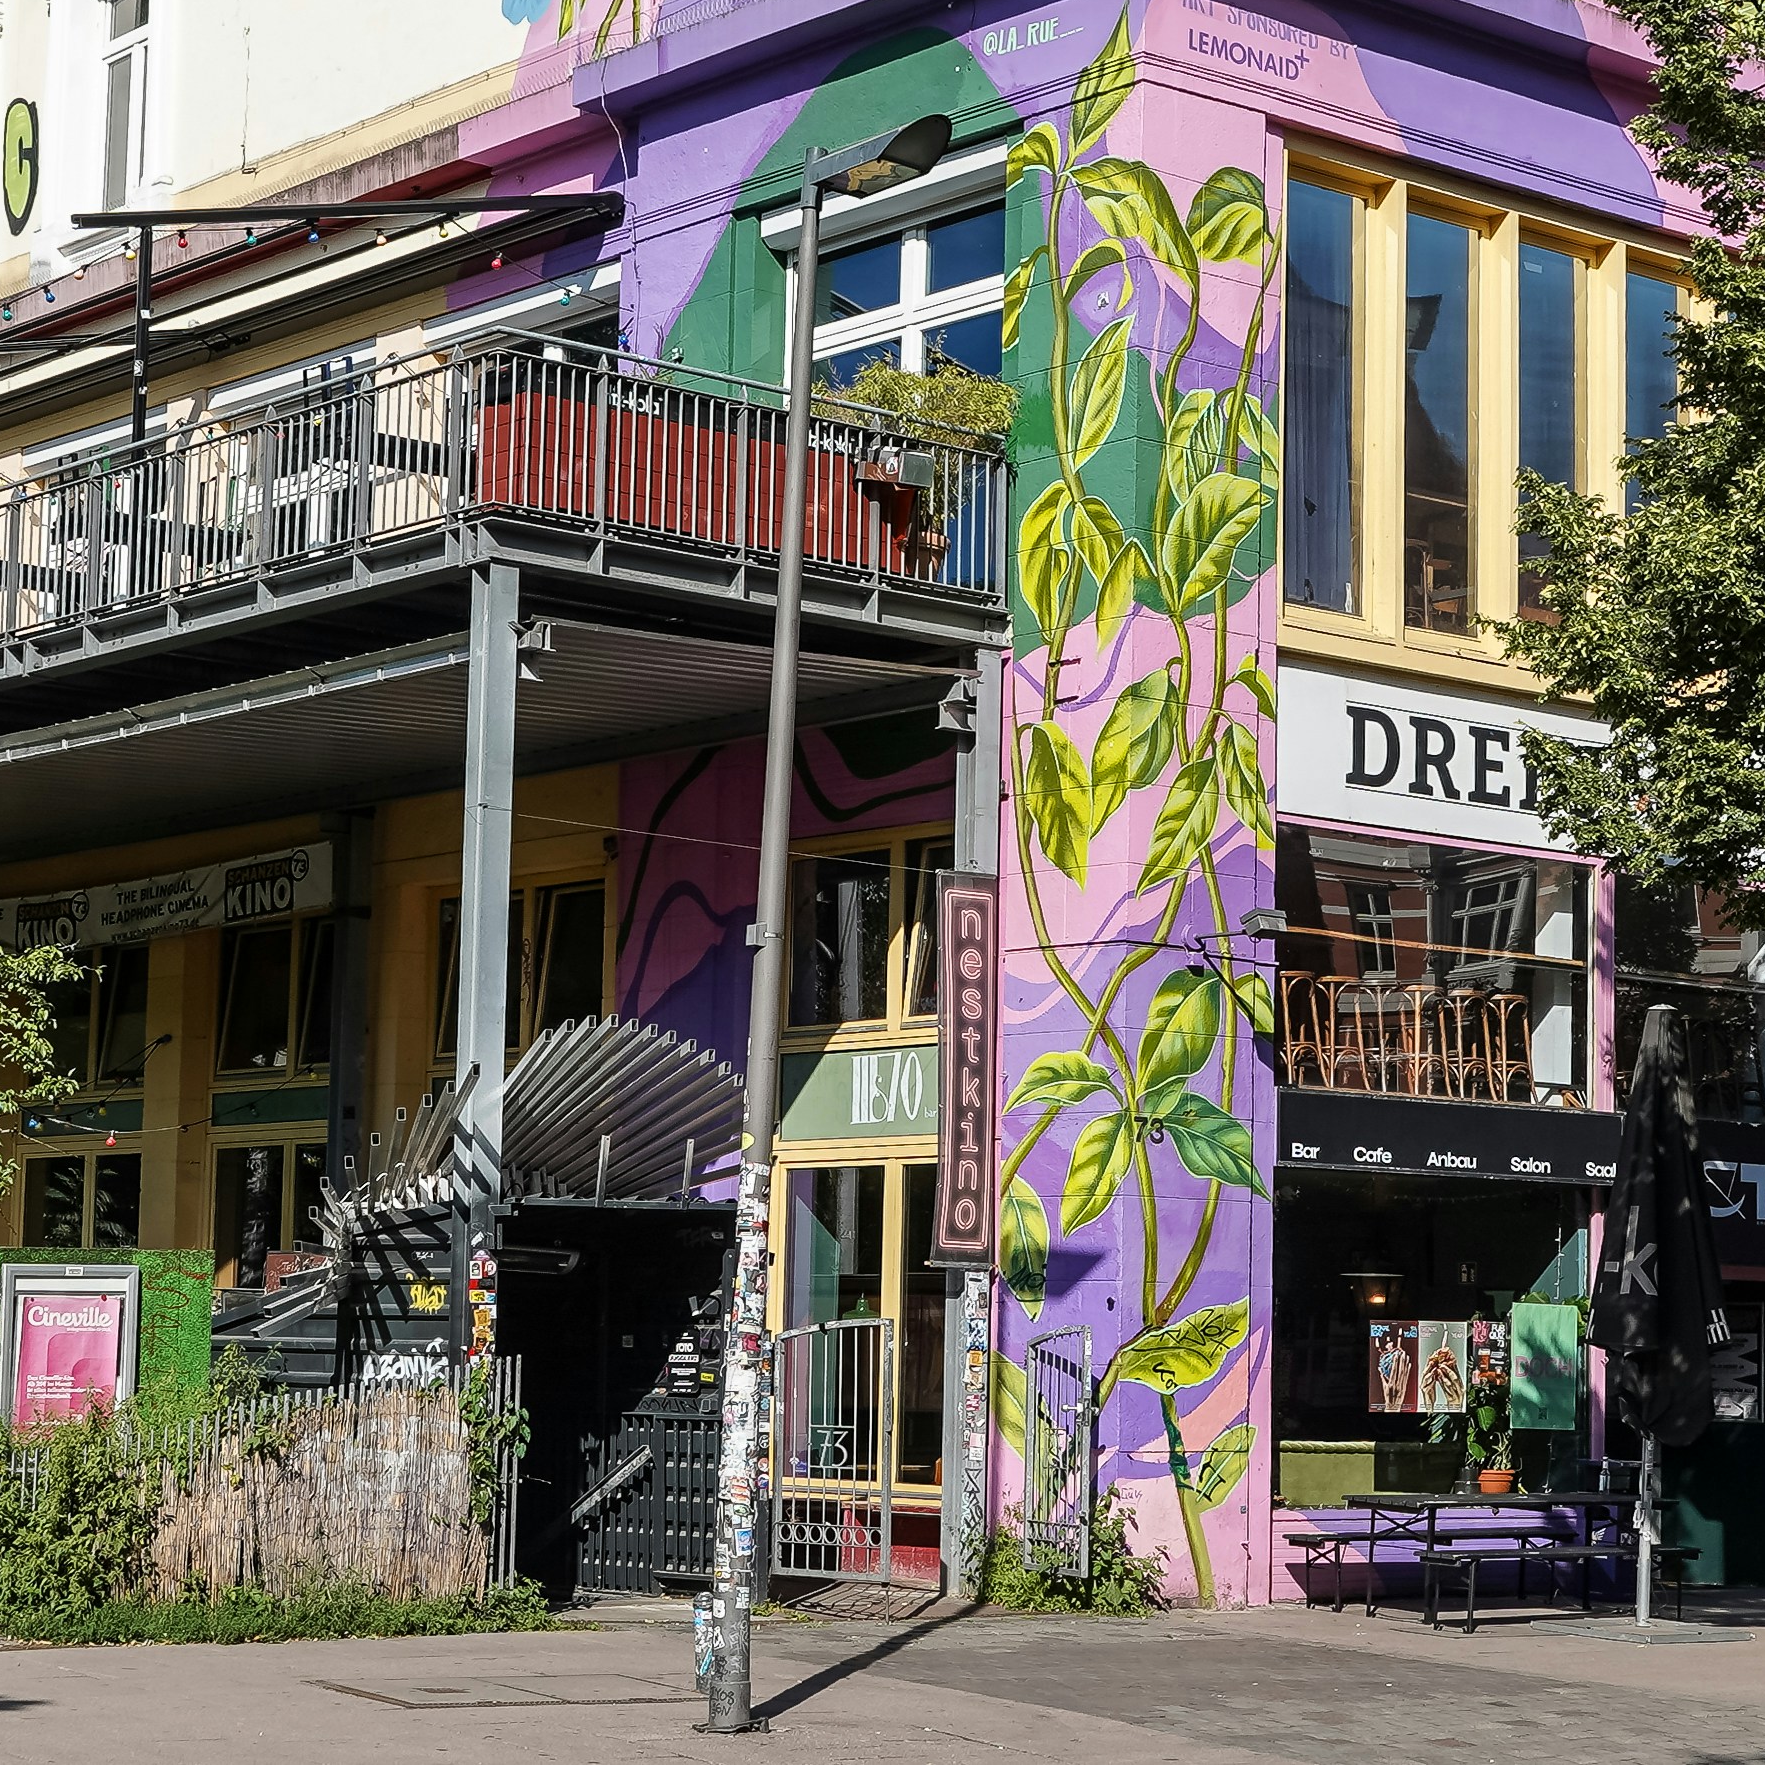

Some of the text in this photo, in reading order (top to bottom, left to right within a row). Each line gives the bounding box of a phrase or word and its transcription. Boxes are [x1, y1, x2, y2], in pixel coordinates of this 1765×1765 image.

[1227, 5, 1319, 50] SPONSORED
[1329, 38, 1351, 60] BY
[293, 858, 308, 874] 73
[73, 900, 88, 915] 73
[116, 879, 195, 905] THE BILINGUAL
[226, 876, 295, 919] KINO
[101, 895, 209, 926] HEADPHONE CINEMA
[16, 916, 77, 951] KINO
[952, 907, 983, 1231] nestkino
[1134, 1116, 1165, 1145] 73
[1291, 1142, 1618, 1179] Bar Cafe Anbau Salon Saal
[27, 1305, 114, 1328] Cineville
[1515, 1355, 1572, 1379] DOCH
[820, 1430, 849, 1468] 73
